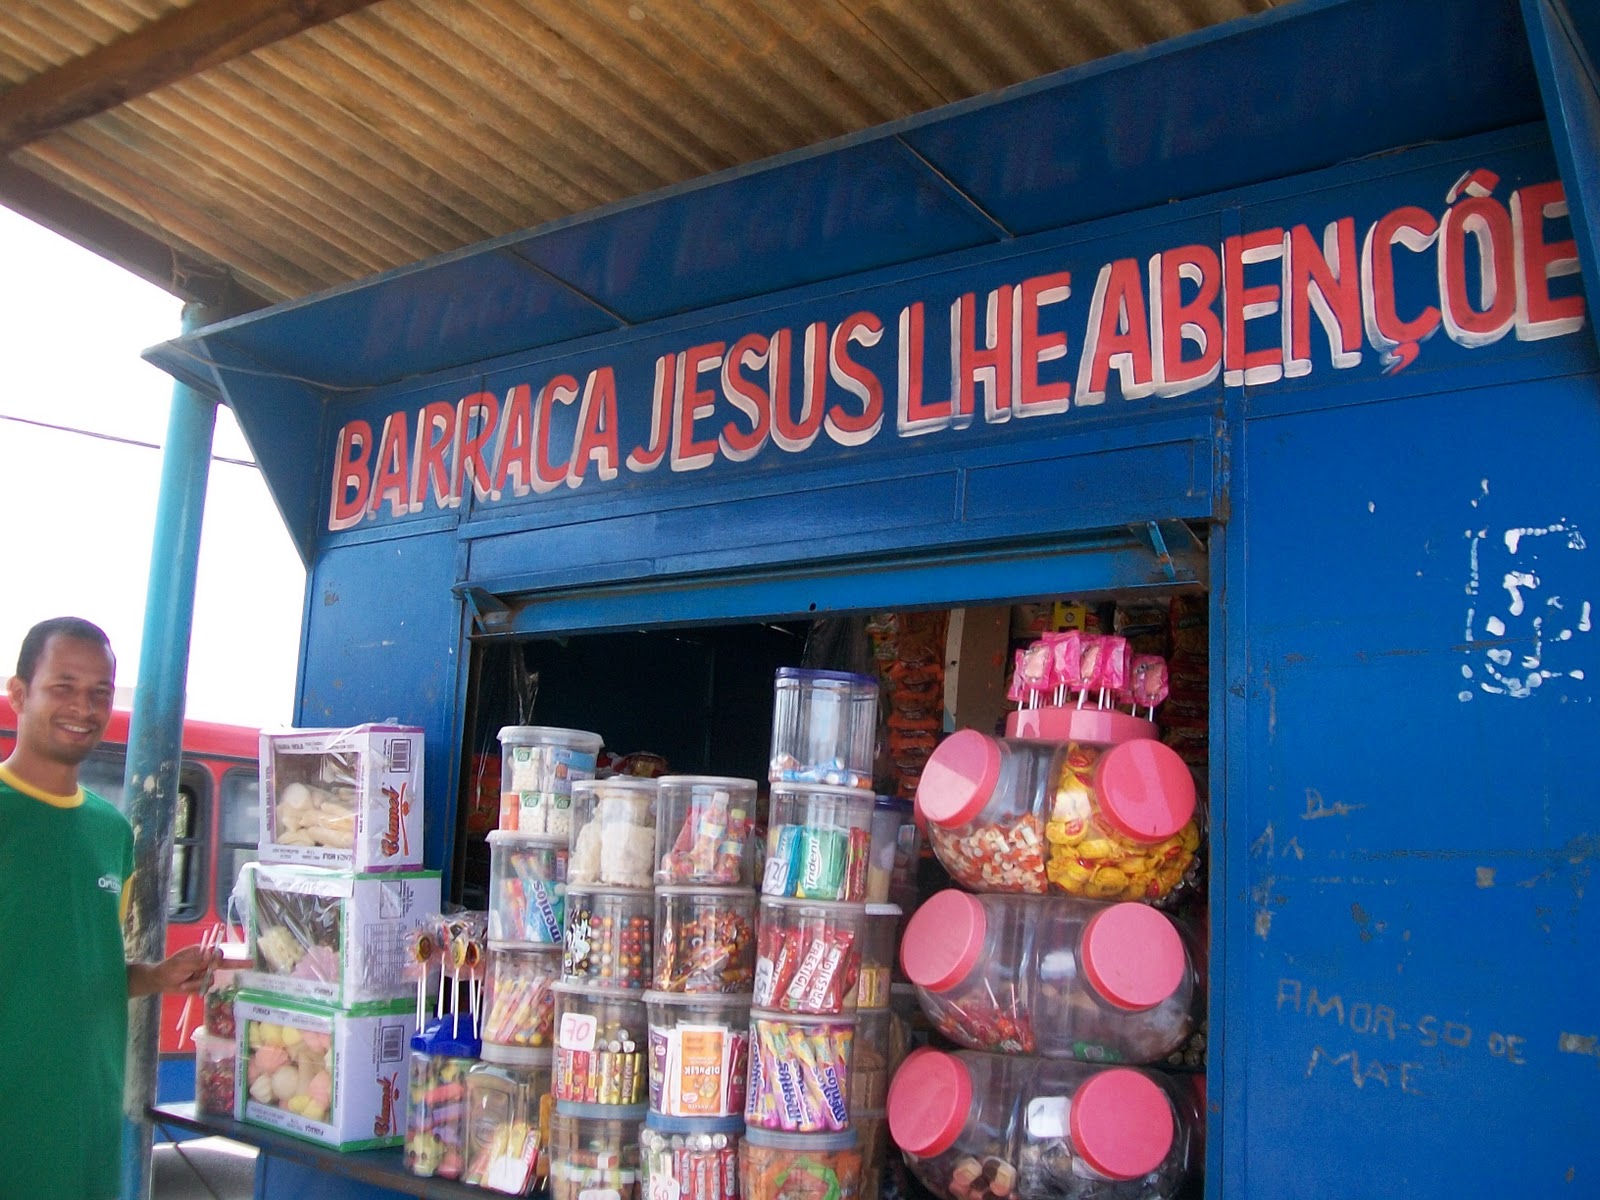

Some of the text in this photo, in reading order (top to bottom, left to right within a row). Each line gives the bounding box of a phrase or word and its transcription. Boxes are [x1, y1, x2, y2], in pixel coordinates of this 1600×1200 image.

[329, 366, 620, 532] BARRACA
[626, 311, 886, 473] JESUS
[897, 271, 1071, 436] LHE
[805, 839, 820, 888] Trident
[533, 880, 562, 944] mentos
[564, 1017, 591, 1042] 70
